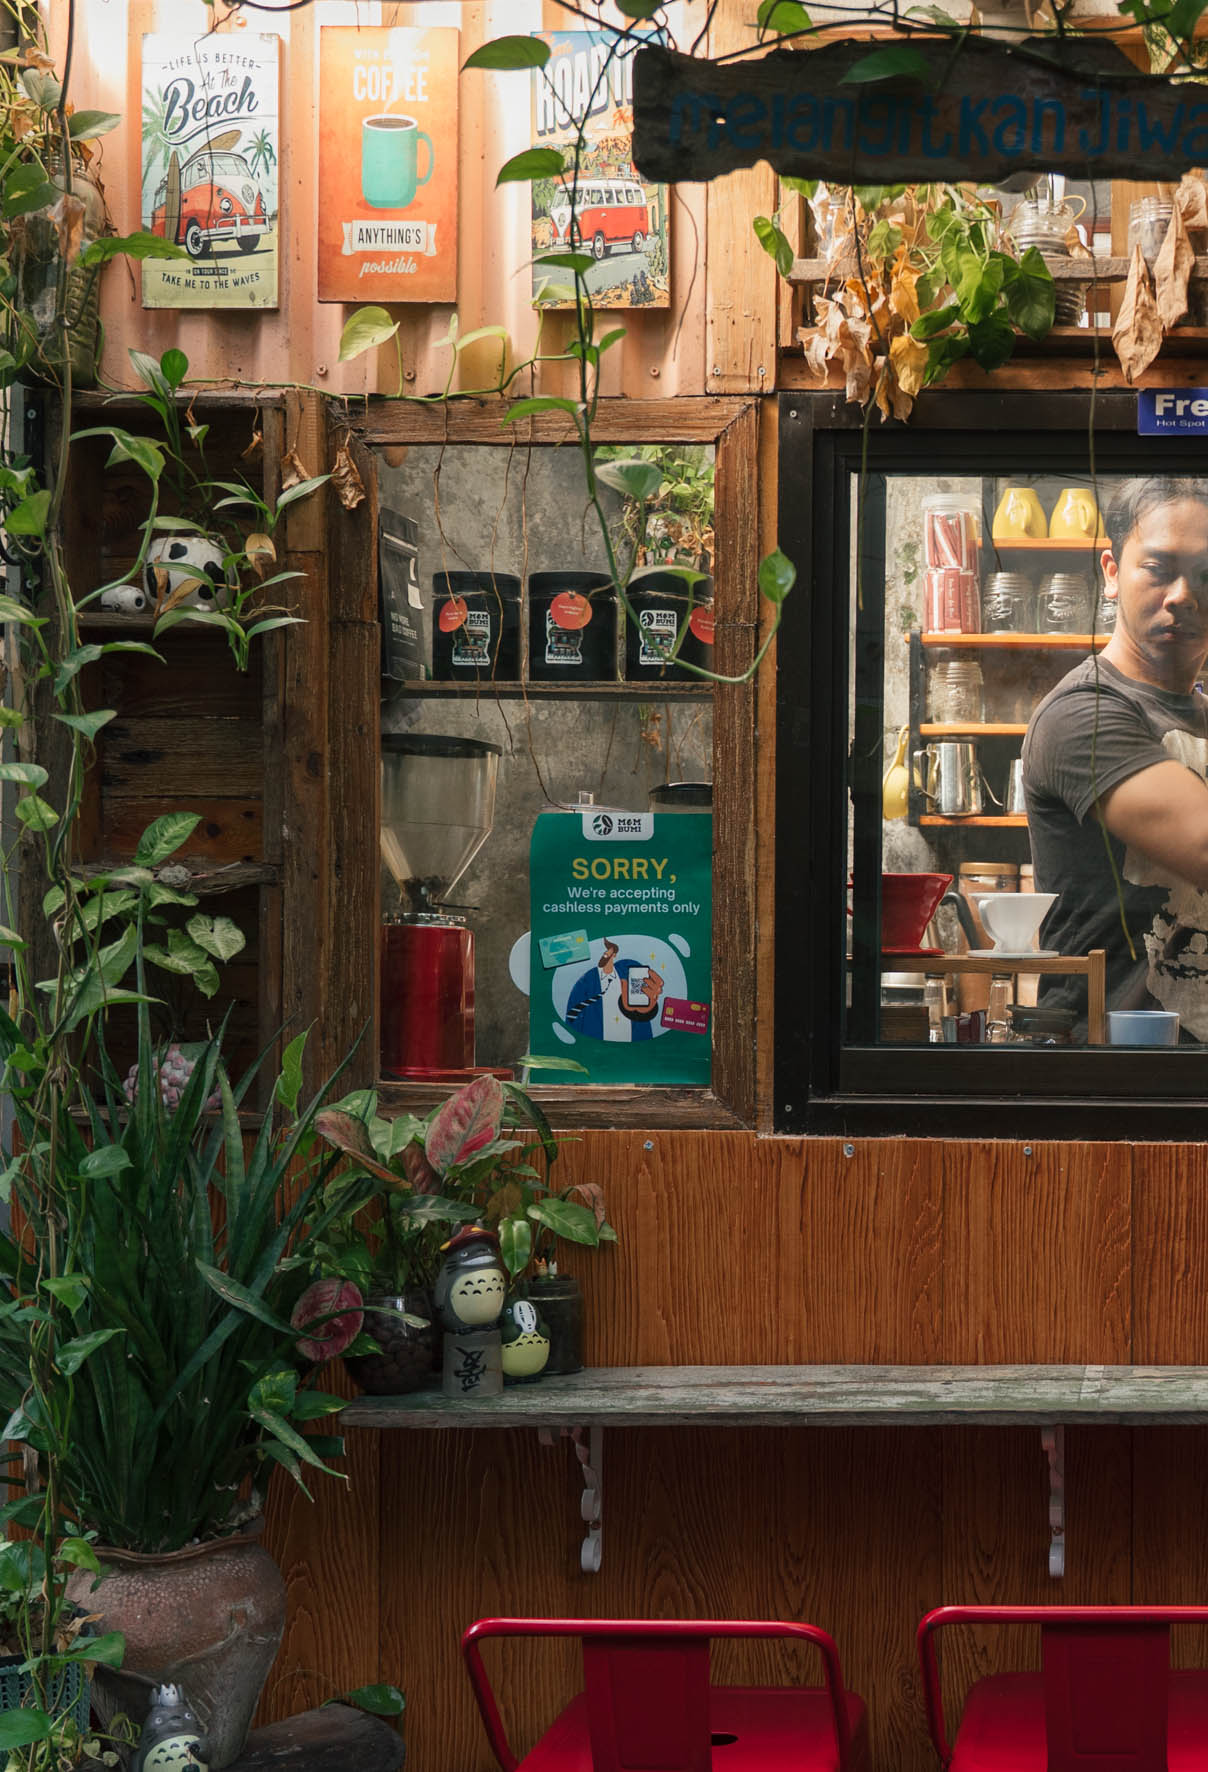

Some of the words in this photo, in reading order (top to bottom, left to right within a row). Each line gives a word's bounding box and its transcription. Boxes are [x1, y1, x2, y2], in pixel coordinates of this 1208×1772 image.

[169, 55, 193, 71] LIFE
[215, 52, 257, 70] BETTER
[217, 68, 238, 90] The
[163, 75, 259, 136] Beach
[358, 227, 422, 245] ANYTHING'S
[358, 255, 418, 279] possible
[161, 272, 182, 287] TAKE
[184, 279, 197, 289] ME
[200, 280, 211, 289] TO
[213, 279, 229, 289] THE
[232, 272, 261, 287] WAVES
[1156, 419, 1177, 428] Hot
[1179, 419, 1206, 429] Spot
[617, 825, 642, 833] BUMI
[572, 857, 677, 884] SORRY,
[567, 886, 607, 899] We're
[609, 887, 676, 901] accepting
[542, 901, 601, 914] cashless
[604, 901, 669, 916] payments
[672, 901, 701, 916] only
